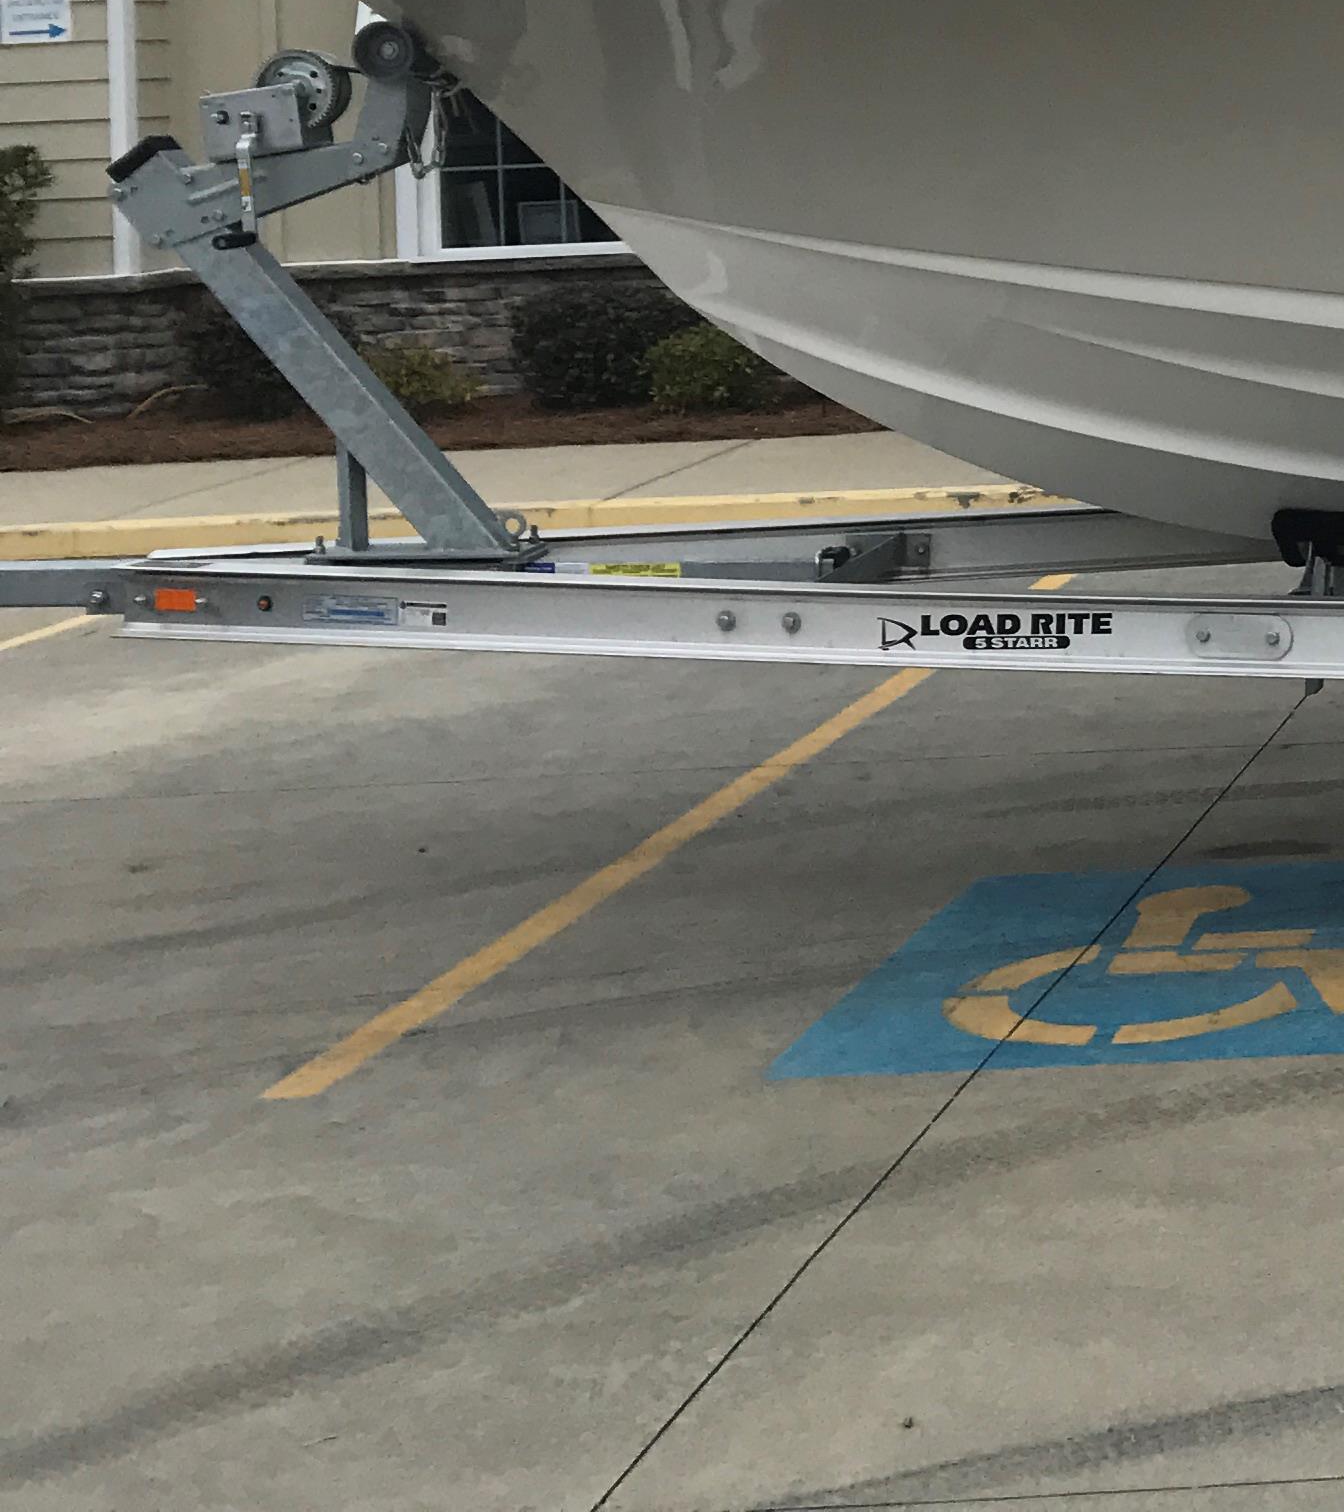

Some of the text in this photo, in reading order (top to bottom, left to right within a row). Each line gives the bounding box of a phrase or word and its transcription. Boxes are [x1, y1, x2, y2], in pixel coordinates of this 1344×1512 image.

[920, 612, 1113, 636] LOAD RITE
[974, 637, 1059, 649] 5 STARR
